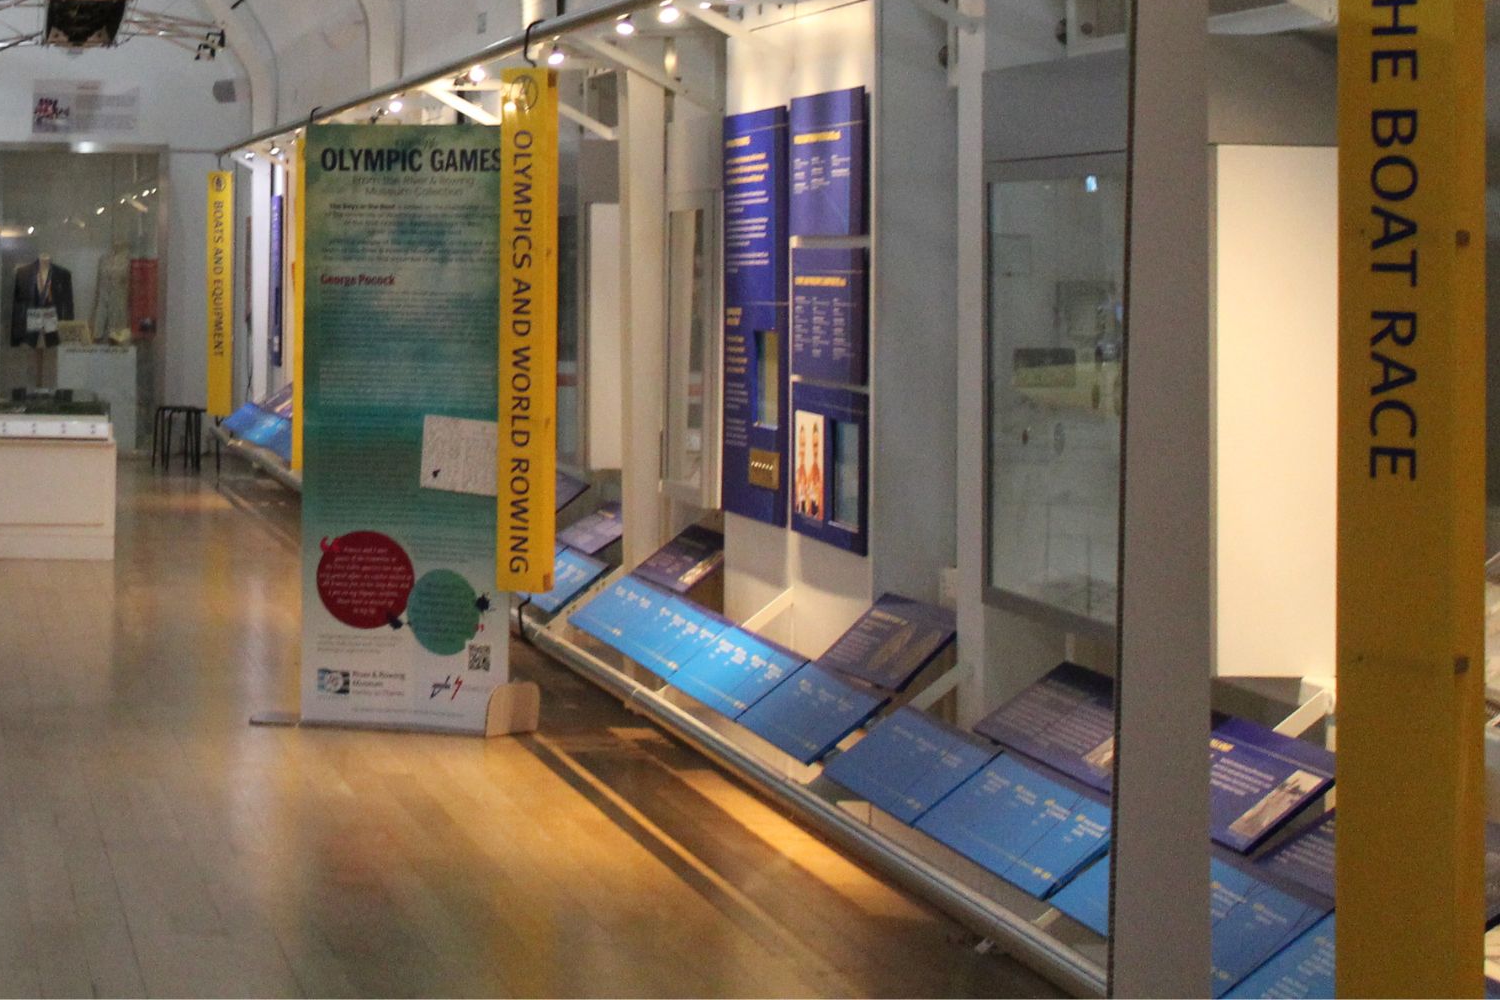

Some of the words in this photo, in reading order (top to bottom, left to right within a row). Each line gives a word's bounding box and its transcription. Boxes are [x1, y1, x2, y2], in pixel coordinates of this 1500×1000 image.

[320, 147, 423, 172] OLYMPIC
[430, 148, 502, 173] GAMES
[511, 129, 533, 270] OLYMPICS
[1370, 108, 1418, 288] BOAT
[212, 247, 223, 275] AND
[213, 200, 224, 244] BOATS
[212, 278, 224, 357] EQUIPMENT
[320, 273, 357, 286] George
[358, 272, 396, 286] Pocock
[511, 277, 531, 337] AND
[510, 346, 531, 448] WORLD
[1369, 310, 1418, 481] RACE
[509, 457, 530, 575] ROWING
